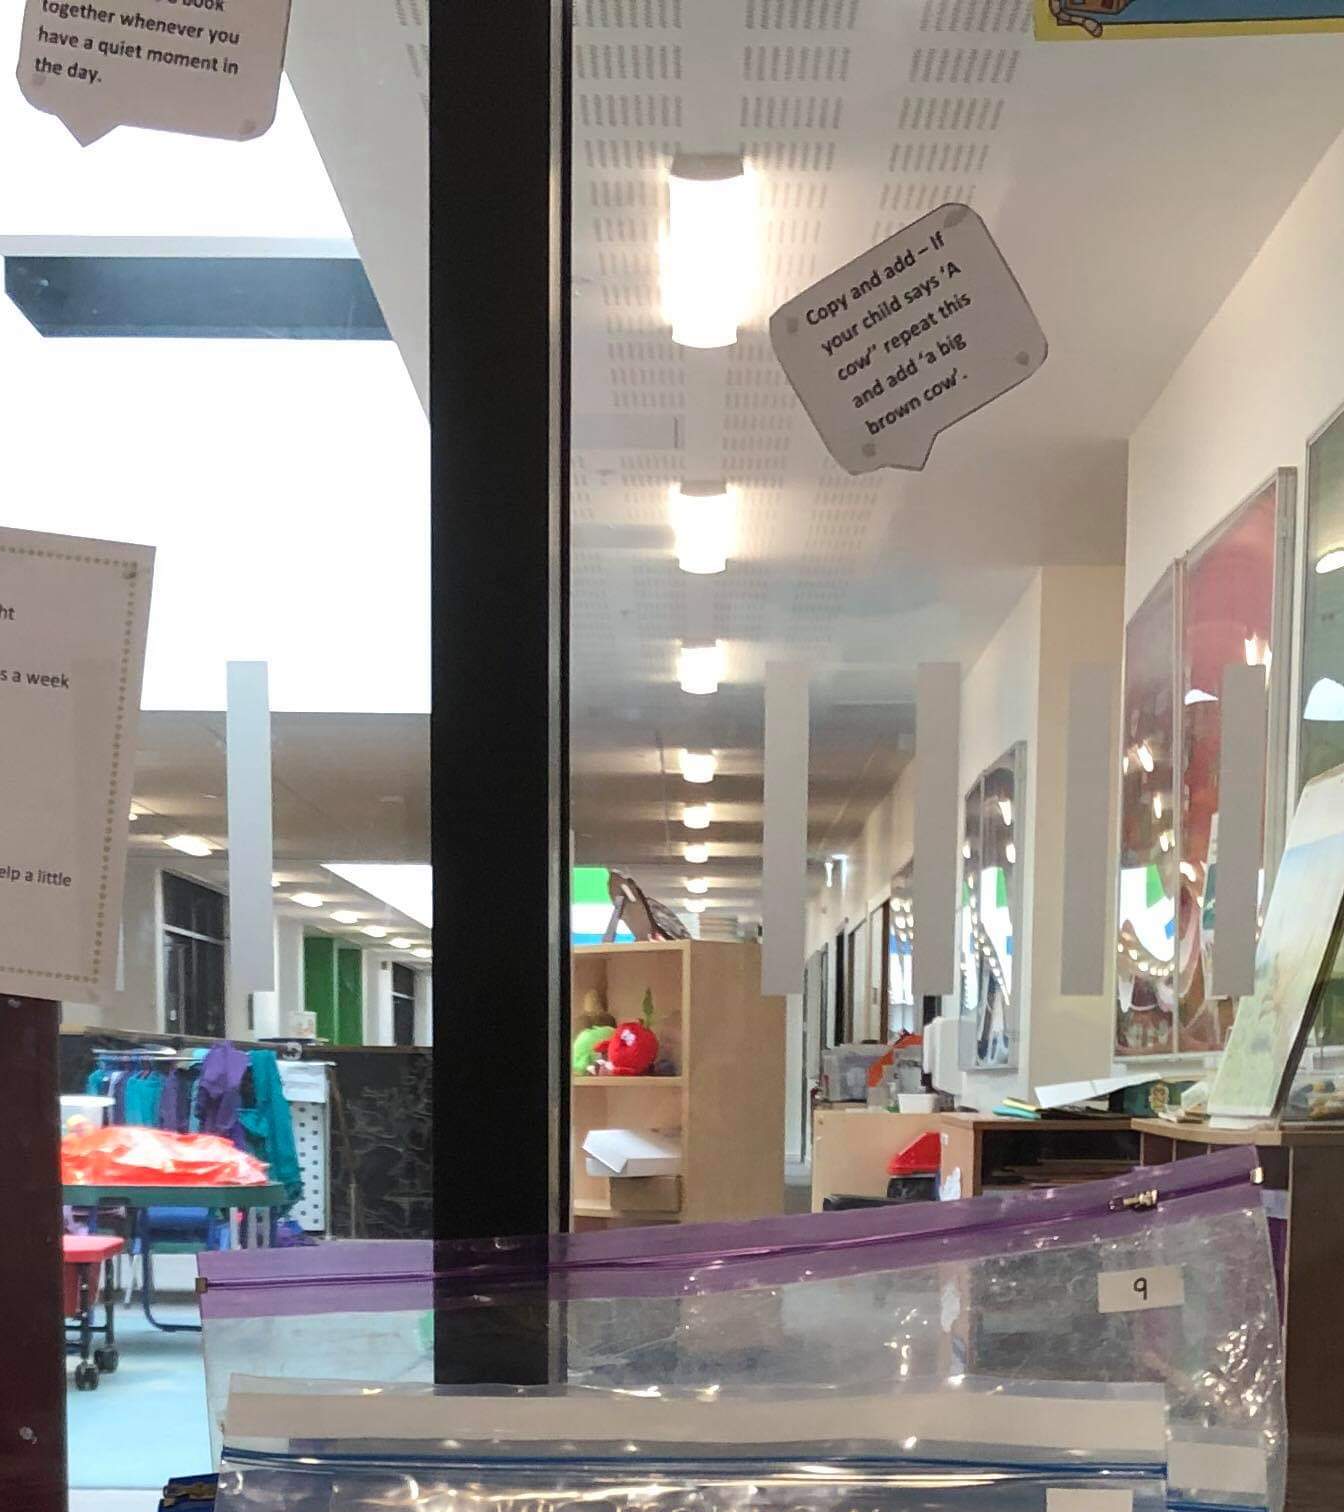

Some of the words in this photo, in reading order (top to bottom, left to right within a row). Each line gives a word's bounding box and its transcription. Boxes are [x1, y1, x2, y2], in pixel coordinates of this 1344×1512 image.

[42, 0, 116, 24] together
[119, 12, 205, 39] whenever
[208, 28, 240, 45] you
[34, 56, 63, 76] the
[66, 61, 102, 85] day.
[37, 25, 80, 49] have
[83, 37, 94, 51] a
[97, 40, 143, 59] quiet
[146, 49, 219, 72] moment
[222, 56, 239, 75] in
[805, 293, 849, 326] Copy
[849, 268, 883, 300] and
[883, 248, 917, 280] add
[929, 230, 945, 251] If
[820, 323, 860, 357] your
[862, 294, 903, 330] child
[903, 275, 941, 305] says
[883, 311, 939, 354] repeat
[937, 293, 972, 320] this
[851, 378, 885, 409] and
[886, 357, 919, 389] add
[935, 332, 967, 357] big
[864, 396, 922, 436] brown
[1132, 1276, 1148, 1302] 9
